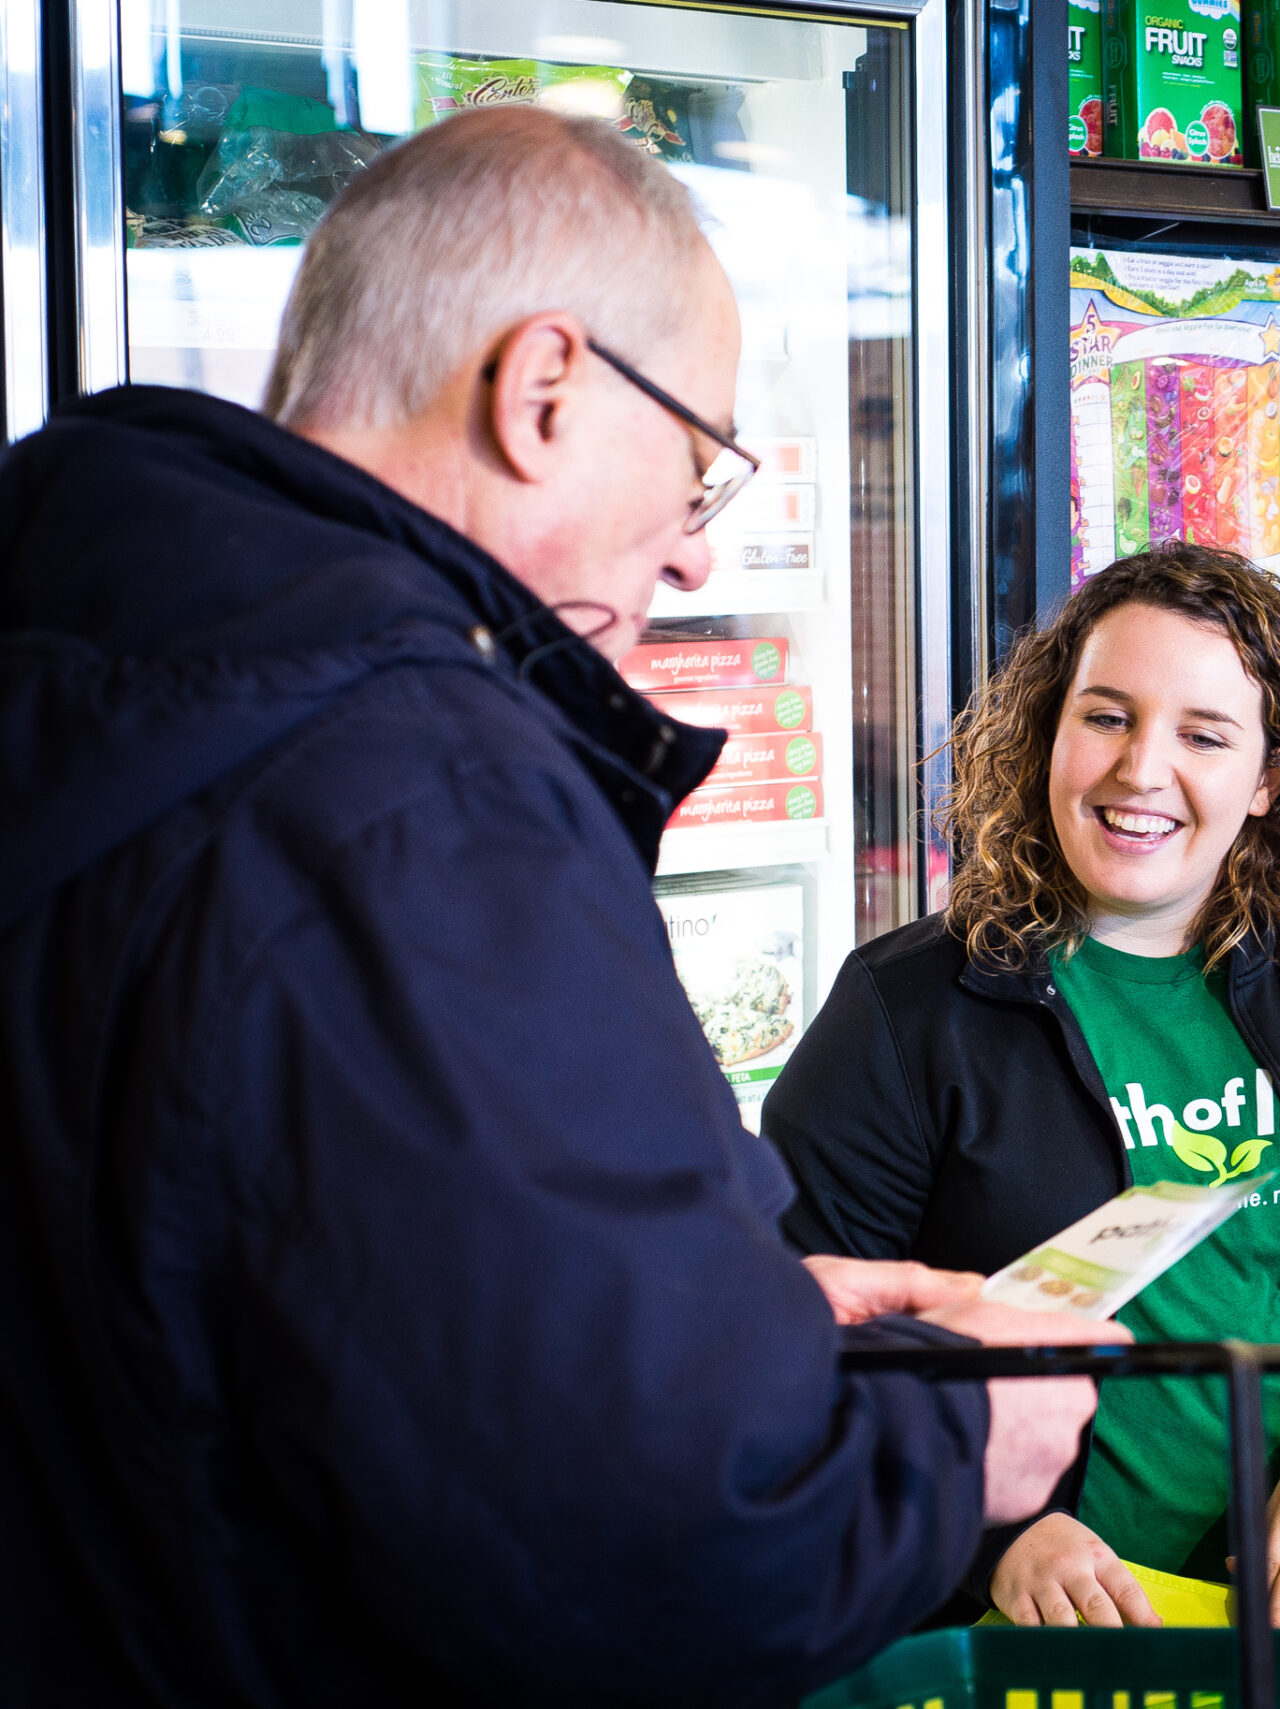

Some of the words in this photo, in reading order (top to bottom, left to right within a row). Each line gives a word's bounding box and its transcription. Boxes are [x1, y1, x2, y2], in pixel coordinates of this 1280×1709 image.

[1145, 15, 1184, 30] ORGANIC
[1145, 26, 1208, 57] FRUIT
[1171, 54, 1204, 68] SNACKS
[1086, 314, 1096, 333] 5
[1070, 334, 1112, 363] STAR
[1070, 354, 1115, 378] DINNER
[742, 546, 808, 566] Gluten-Free
[651, 652, 709, 676] margherita
[710, 652, 741, 673] pizza
[731, 703, 763, 722] pizza
[743, 750, 774, 769] pizza
[680, 799, 741, 822] margherita
[743, 798, 774, 818] pizza
[731, 1072, 751, 1083] FETA
[1109, 1082, 1176, 1149] th
[1182, 1077, 1245, 1131] of
